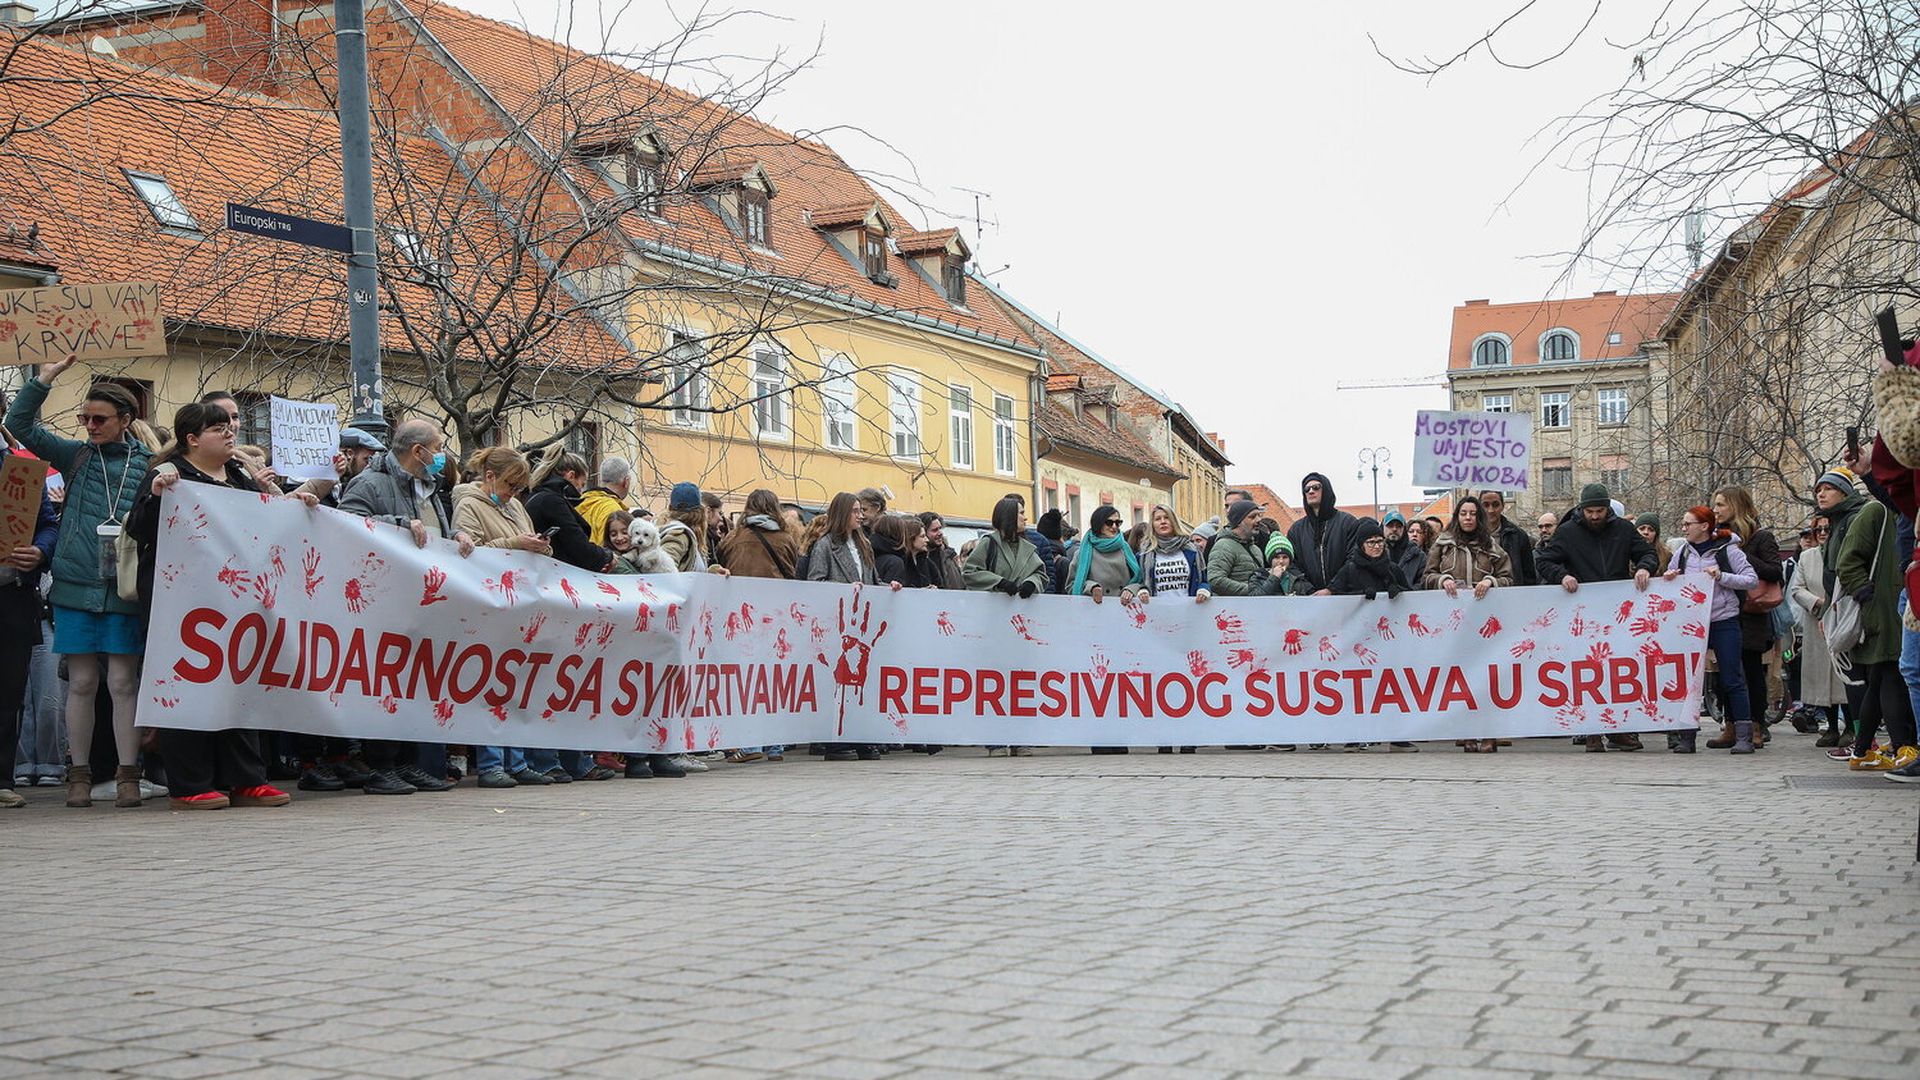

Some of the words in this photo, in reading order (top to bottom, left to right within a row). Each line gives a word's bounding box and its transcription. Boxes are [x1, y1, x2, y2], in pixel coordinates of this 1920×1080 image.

[234, 210, 277, 231] Europski
[278, 222, 292, 231] TRG
[61, 286, 93, 310] SU
[105, 283, 159, 309] VAM
[14, 324, 144, 360] KRVAVE
[1415, 414, 1507, 437] MOSTOVI
[1433, 438, 1526, 464] UMJESTO
[1436, 464, 1528, 489] SUKOBA
[173, 607, 554, 711] SOLIDARNOST
[547, 654, 604, 714] SA
[611, 659, 691, 719] SVIM
[690, 647, 818, 718] ŽRTVAMA
[879, 667, 1233, 719] REPRESIVNOG
[1245, 665, 1478, 717] SUSTAVA
[1488, 663, 1522, 710] U
[1538, 652, 1700, 708] SRBIJ
